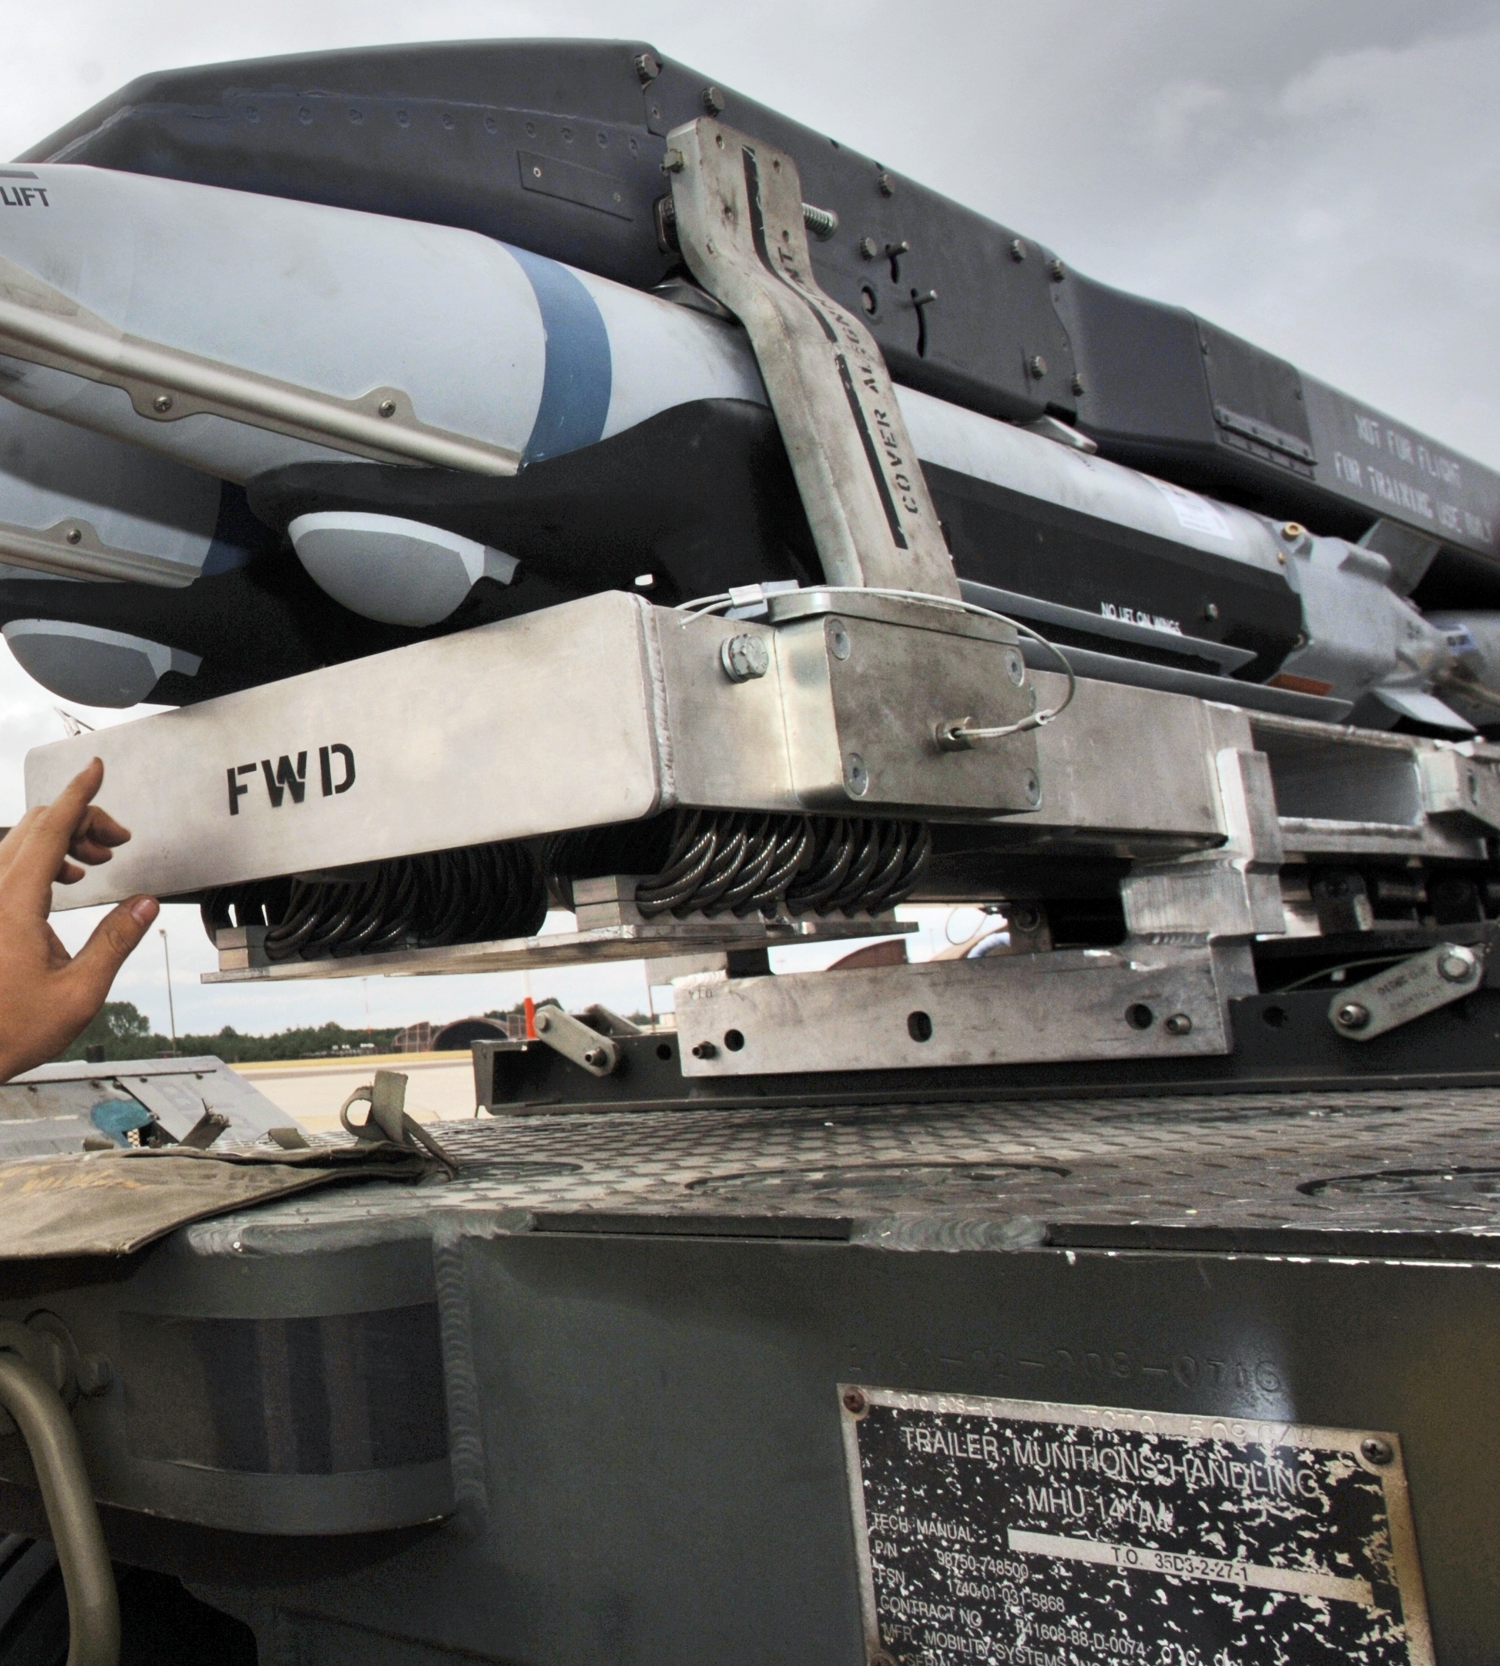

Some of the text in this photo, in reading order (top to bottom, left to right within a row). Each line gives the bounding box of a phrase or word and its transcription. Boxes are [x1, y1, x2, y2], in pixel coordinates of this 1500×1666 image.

[0, 185, 50, 208] LIFT
[778, 247, 919, 514] COVER ALIGNNT
[227, 743, 356, 816] FWD
[1013, 1439, 1159, 1480] MUNITIONS
[1169, 1455, 1319, 1498] HANDLING
[875, 1540, 898, 1557] P/N
[917, 1519, 974, 1542] MANUAL
[1111, 1546, 1143, 1565] T.O.
[880, 1595, 956, 1621] CONTRACT
[924, 1630, 991, 1656] MOBILITY
